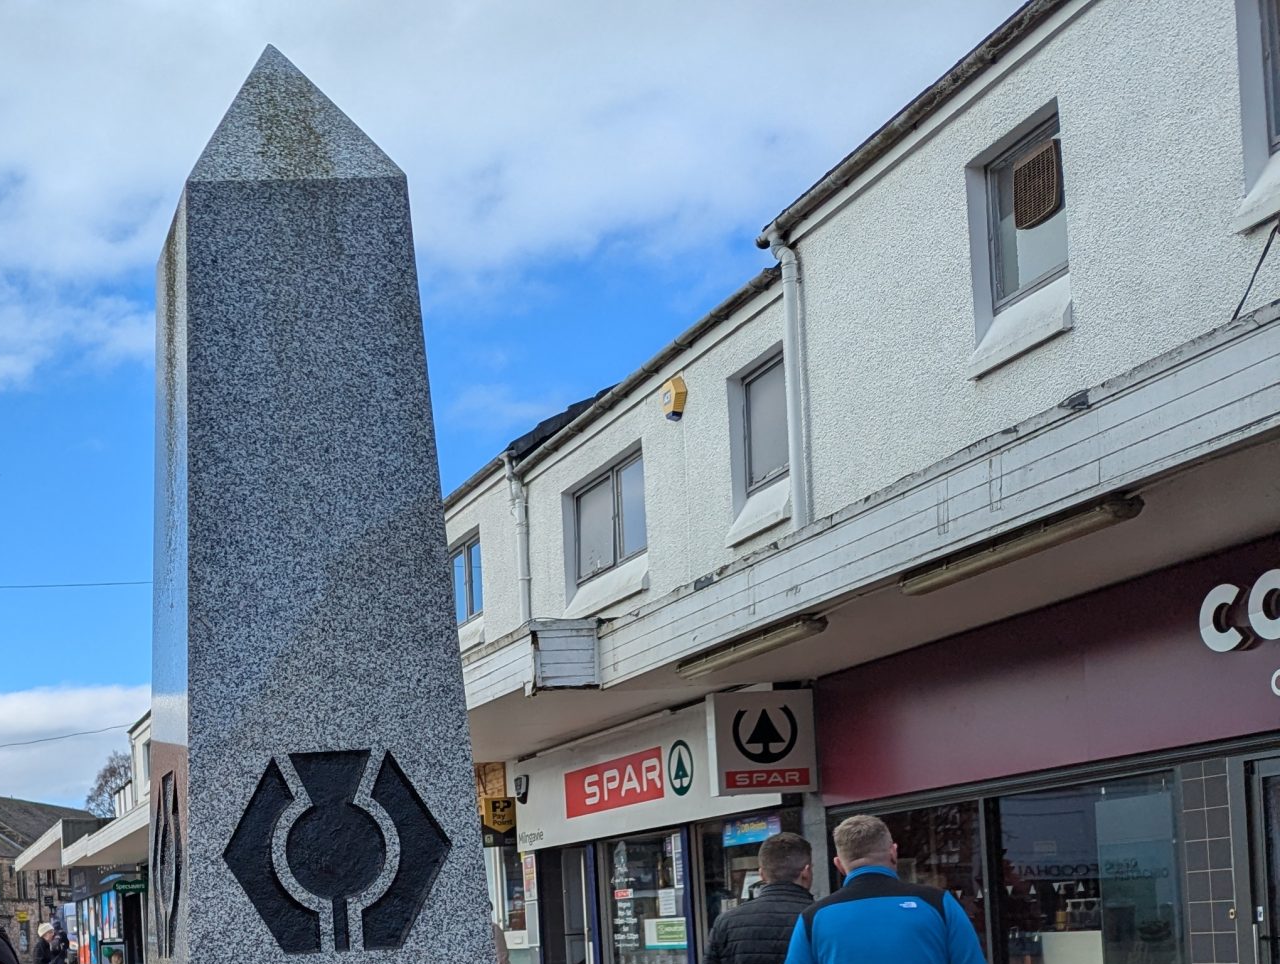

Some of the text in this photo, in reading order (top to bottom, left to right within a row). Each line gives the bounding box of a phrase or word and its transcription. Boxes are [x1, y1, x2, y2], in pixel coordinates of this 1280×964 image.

[584, 757, 662, 806] SPAR
[735, 770, 800, 786] SPAR
[518, 828, 544, 846] Milngavie
